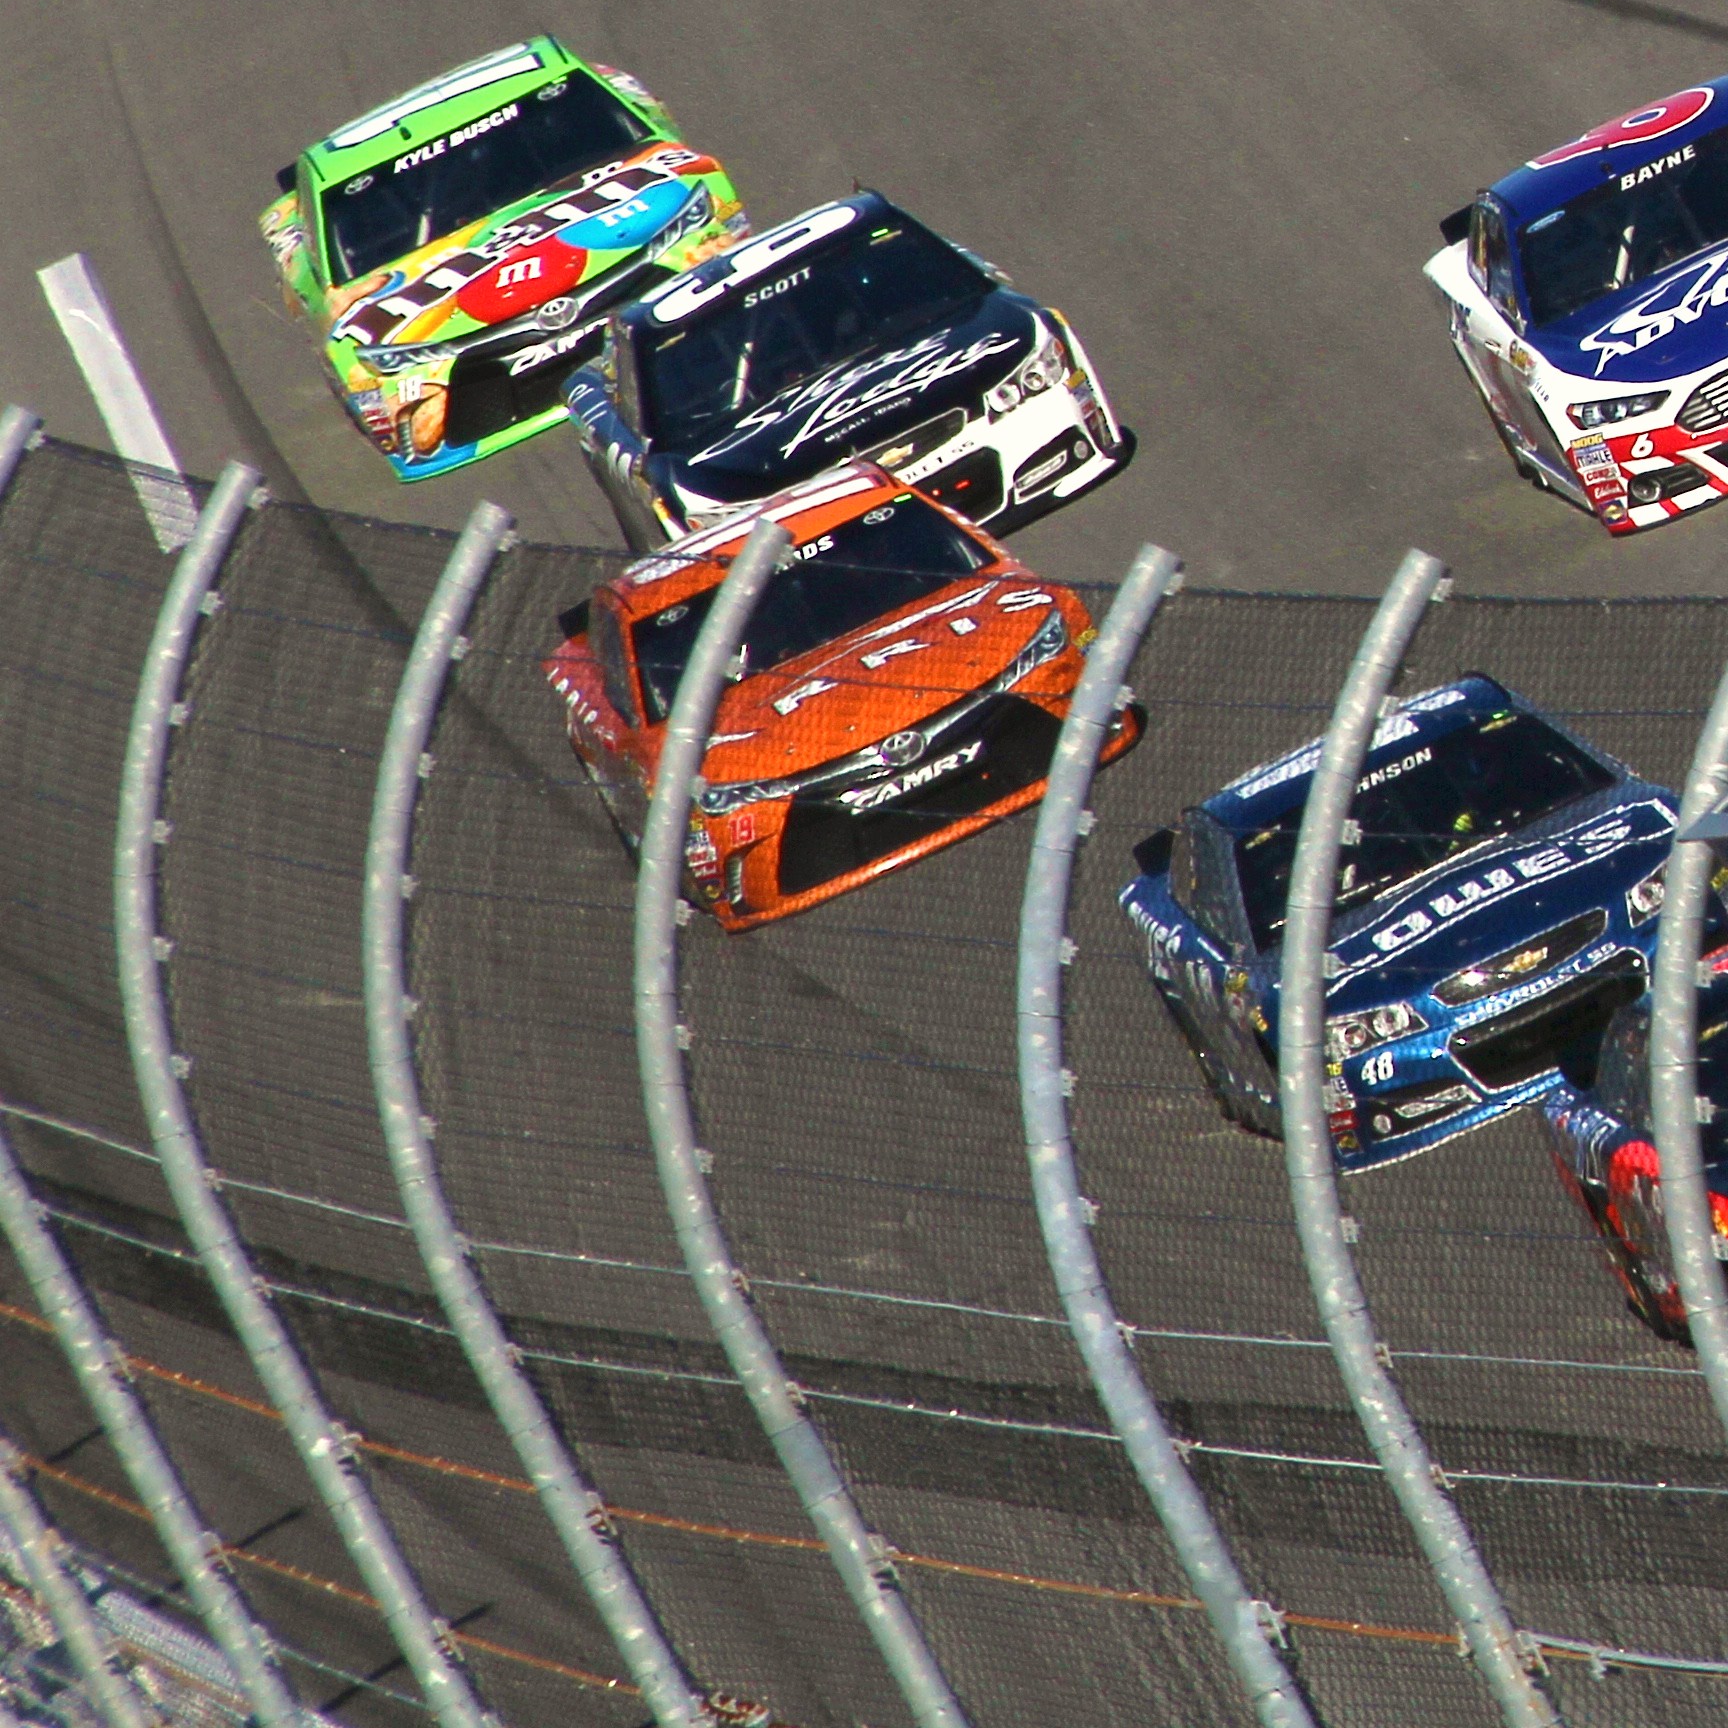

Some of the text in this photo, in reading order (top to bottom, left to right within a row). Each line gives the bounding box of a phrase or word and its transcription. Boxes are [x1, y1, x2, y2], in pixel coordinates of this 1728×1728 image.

[393, 104, 519, 174] KYLE BUSCH
[1620, 144, 1697, 191] BAYNE
[744, 266, 812, 308] SCOTT
[397, 374, 421, 404] 18
[1630, 433, 1654, 459] 6
[849, 740, 984, 815] CAMRY
[1356, 747, 1433, 794] HNSON
[727, 812, 756, 848] 19
[1361, 1050, 1395, 1086] 48
